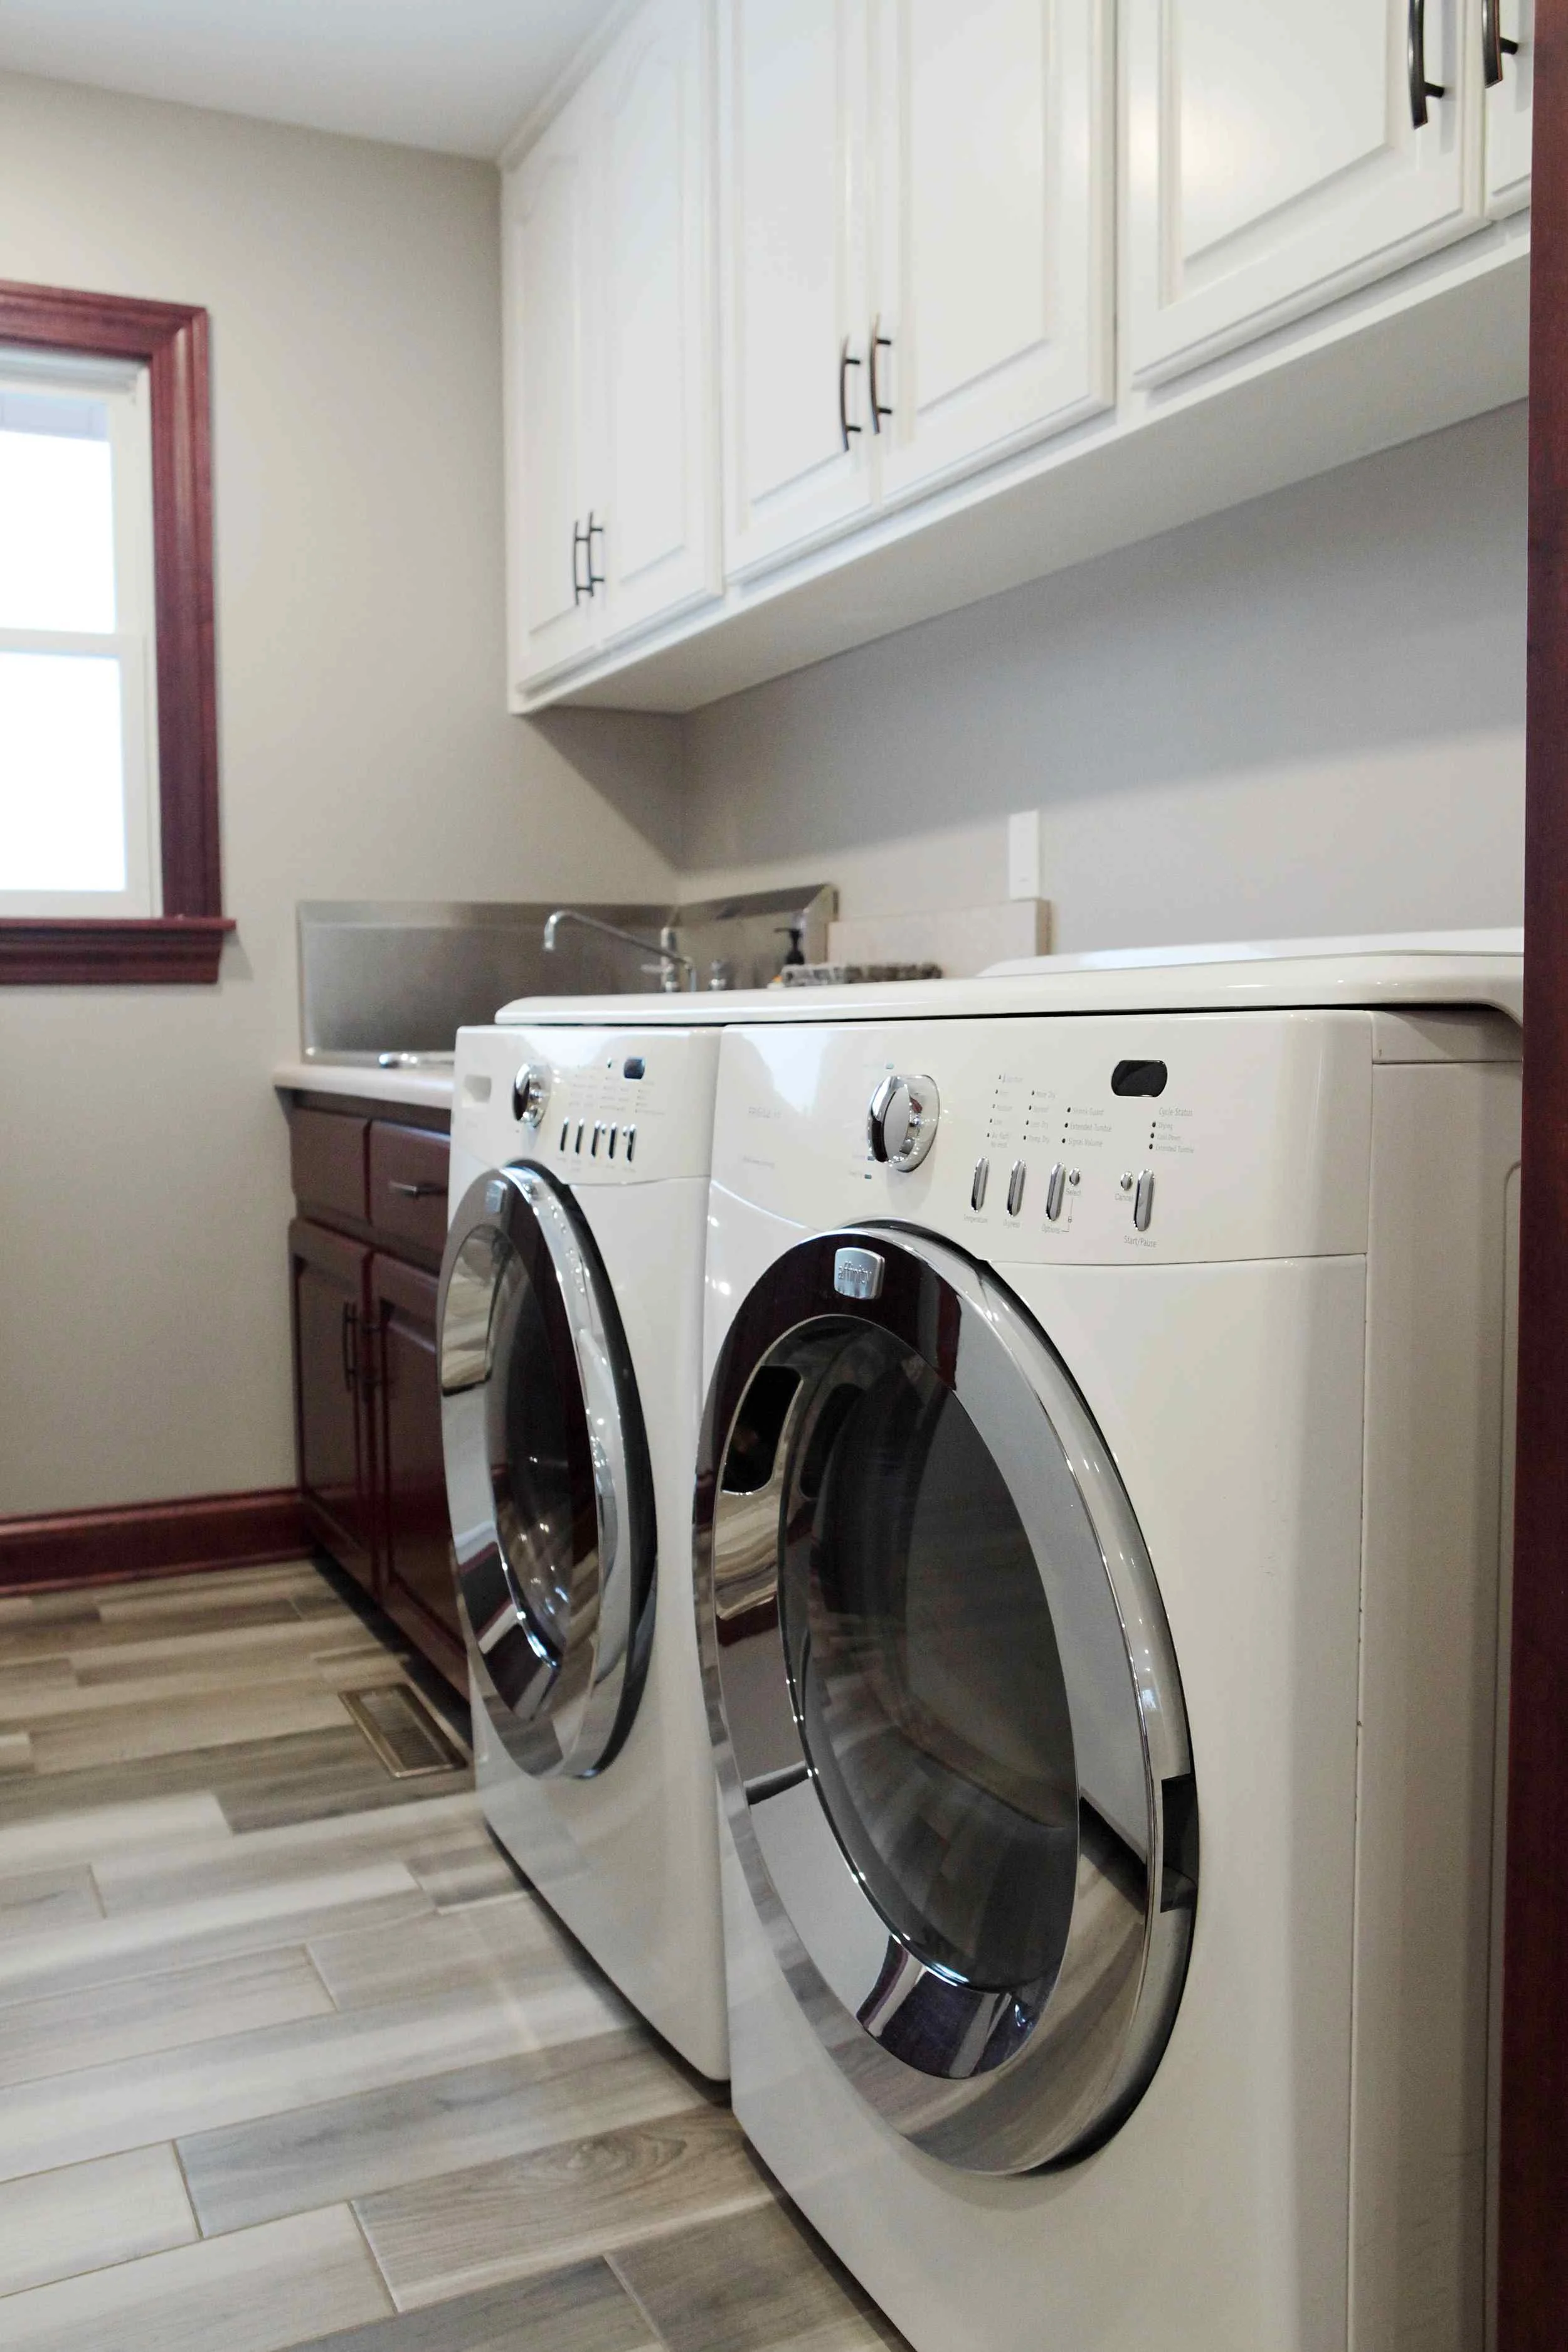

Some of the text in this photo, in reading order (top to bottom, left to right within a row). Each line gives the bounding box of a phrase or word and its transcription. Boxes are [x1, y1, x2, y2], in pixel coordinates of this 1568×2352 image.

[1159, 1107, 1193, 1117] Cycle Status
[1115, 1193, 1133, 1202] Cancel
[1123, 1235, 1158, 1248] Start/Pause
[837, 1261, 869, 1285] affinity
